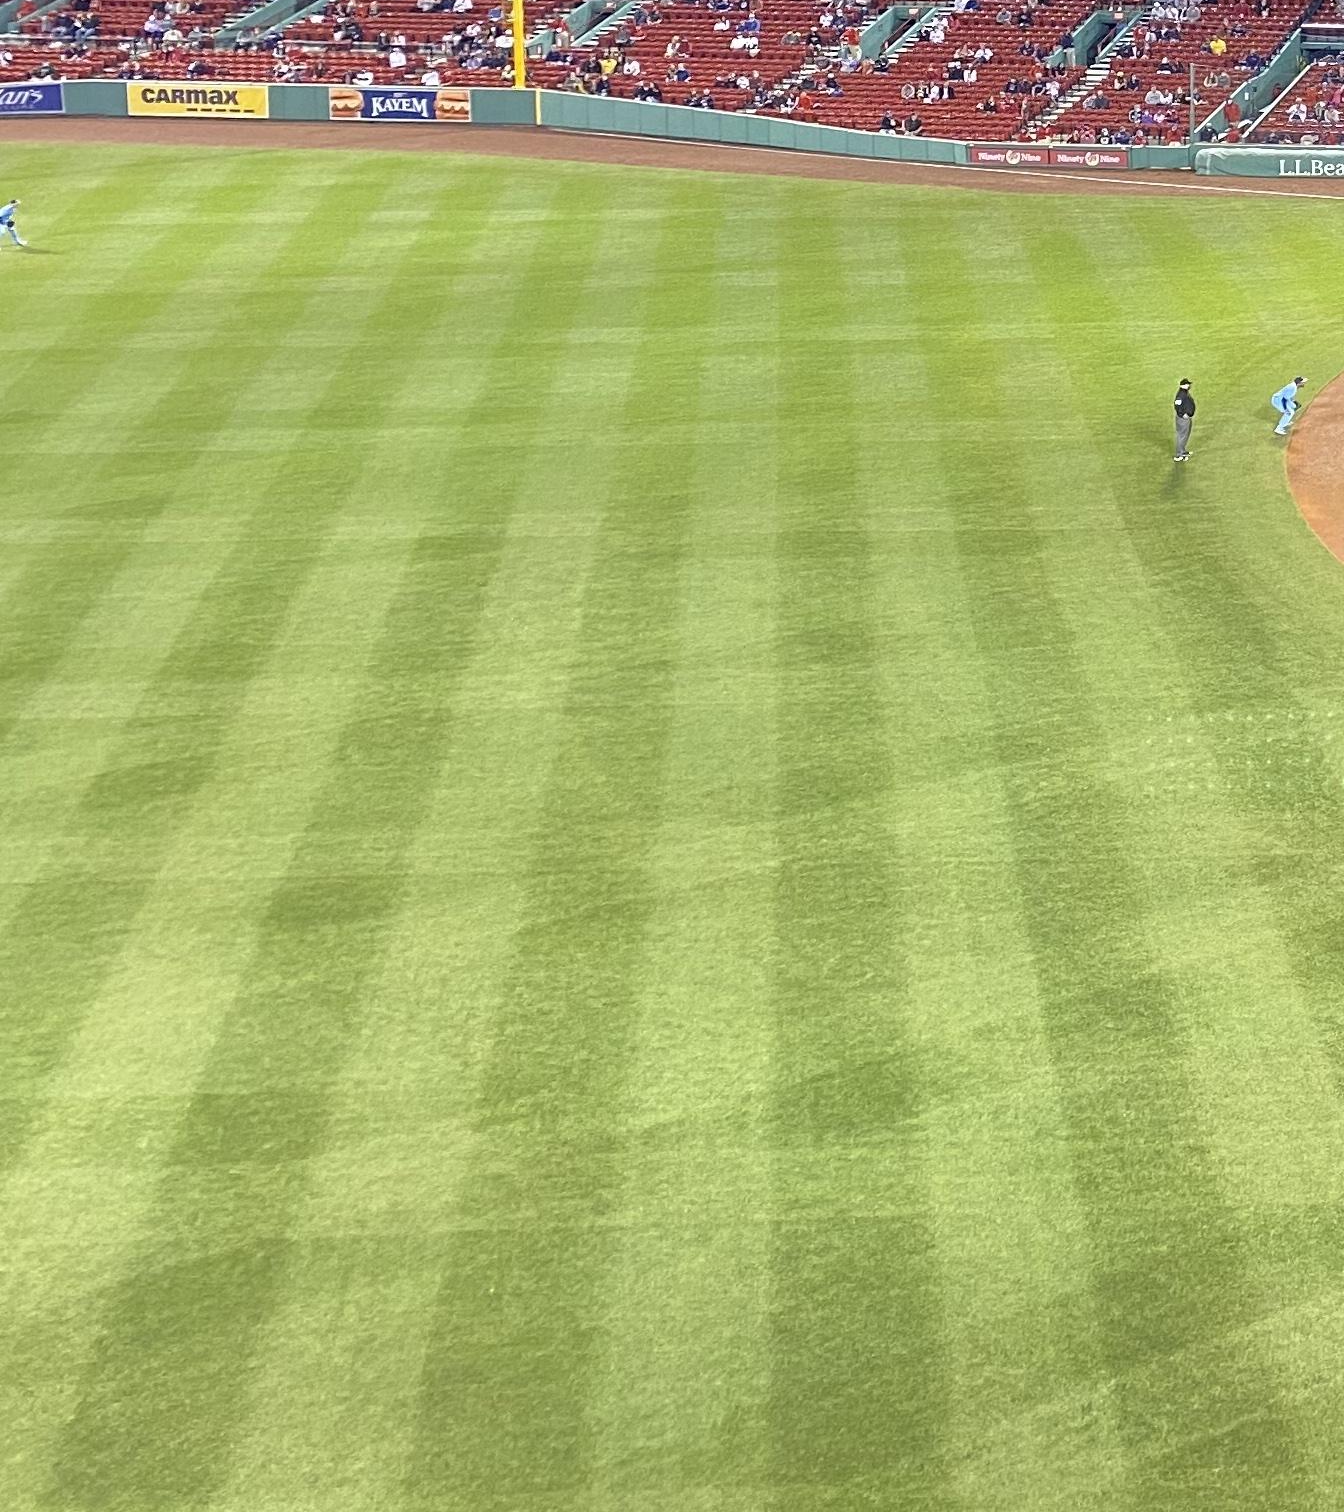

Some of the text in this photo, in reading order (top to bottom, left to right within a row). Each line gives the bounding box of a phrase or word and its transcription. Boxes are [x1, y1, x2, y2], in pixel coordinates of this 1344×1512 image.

[371, 96, 429, 118] KAYEM
[978, 151, 1041, 162] Ninety Nine
[1057, 154, 1120, 164] Ninety Nine
